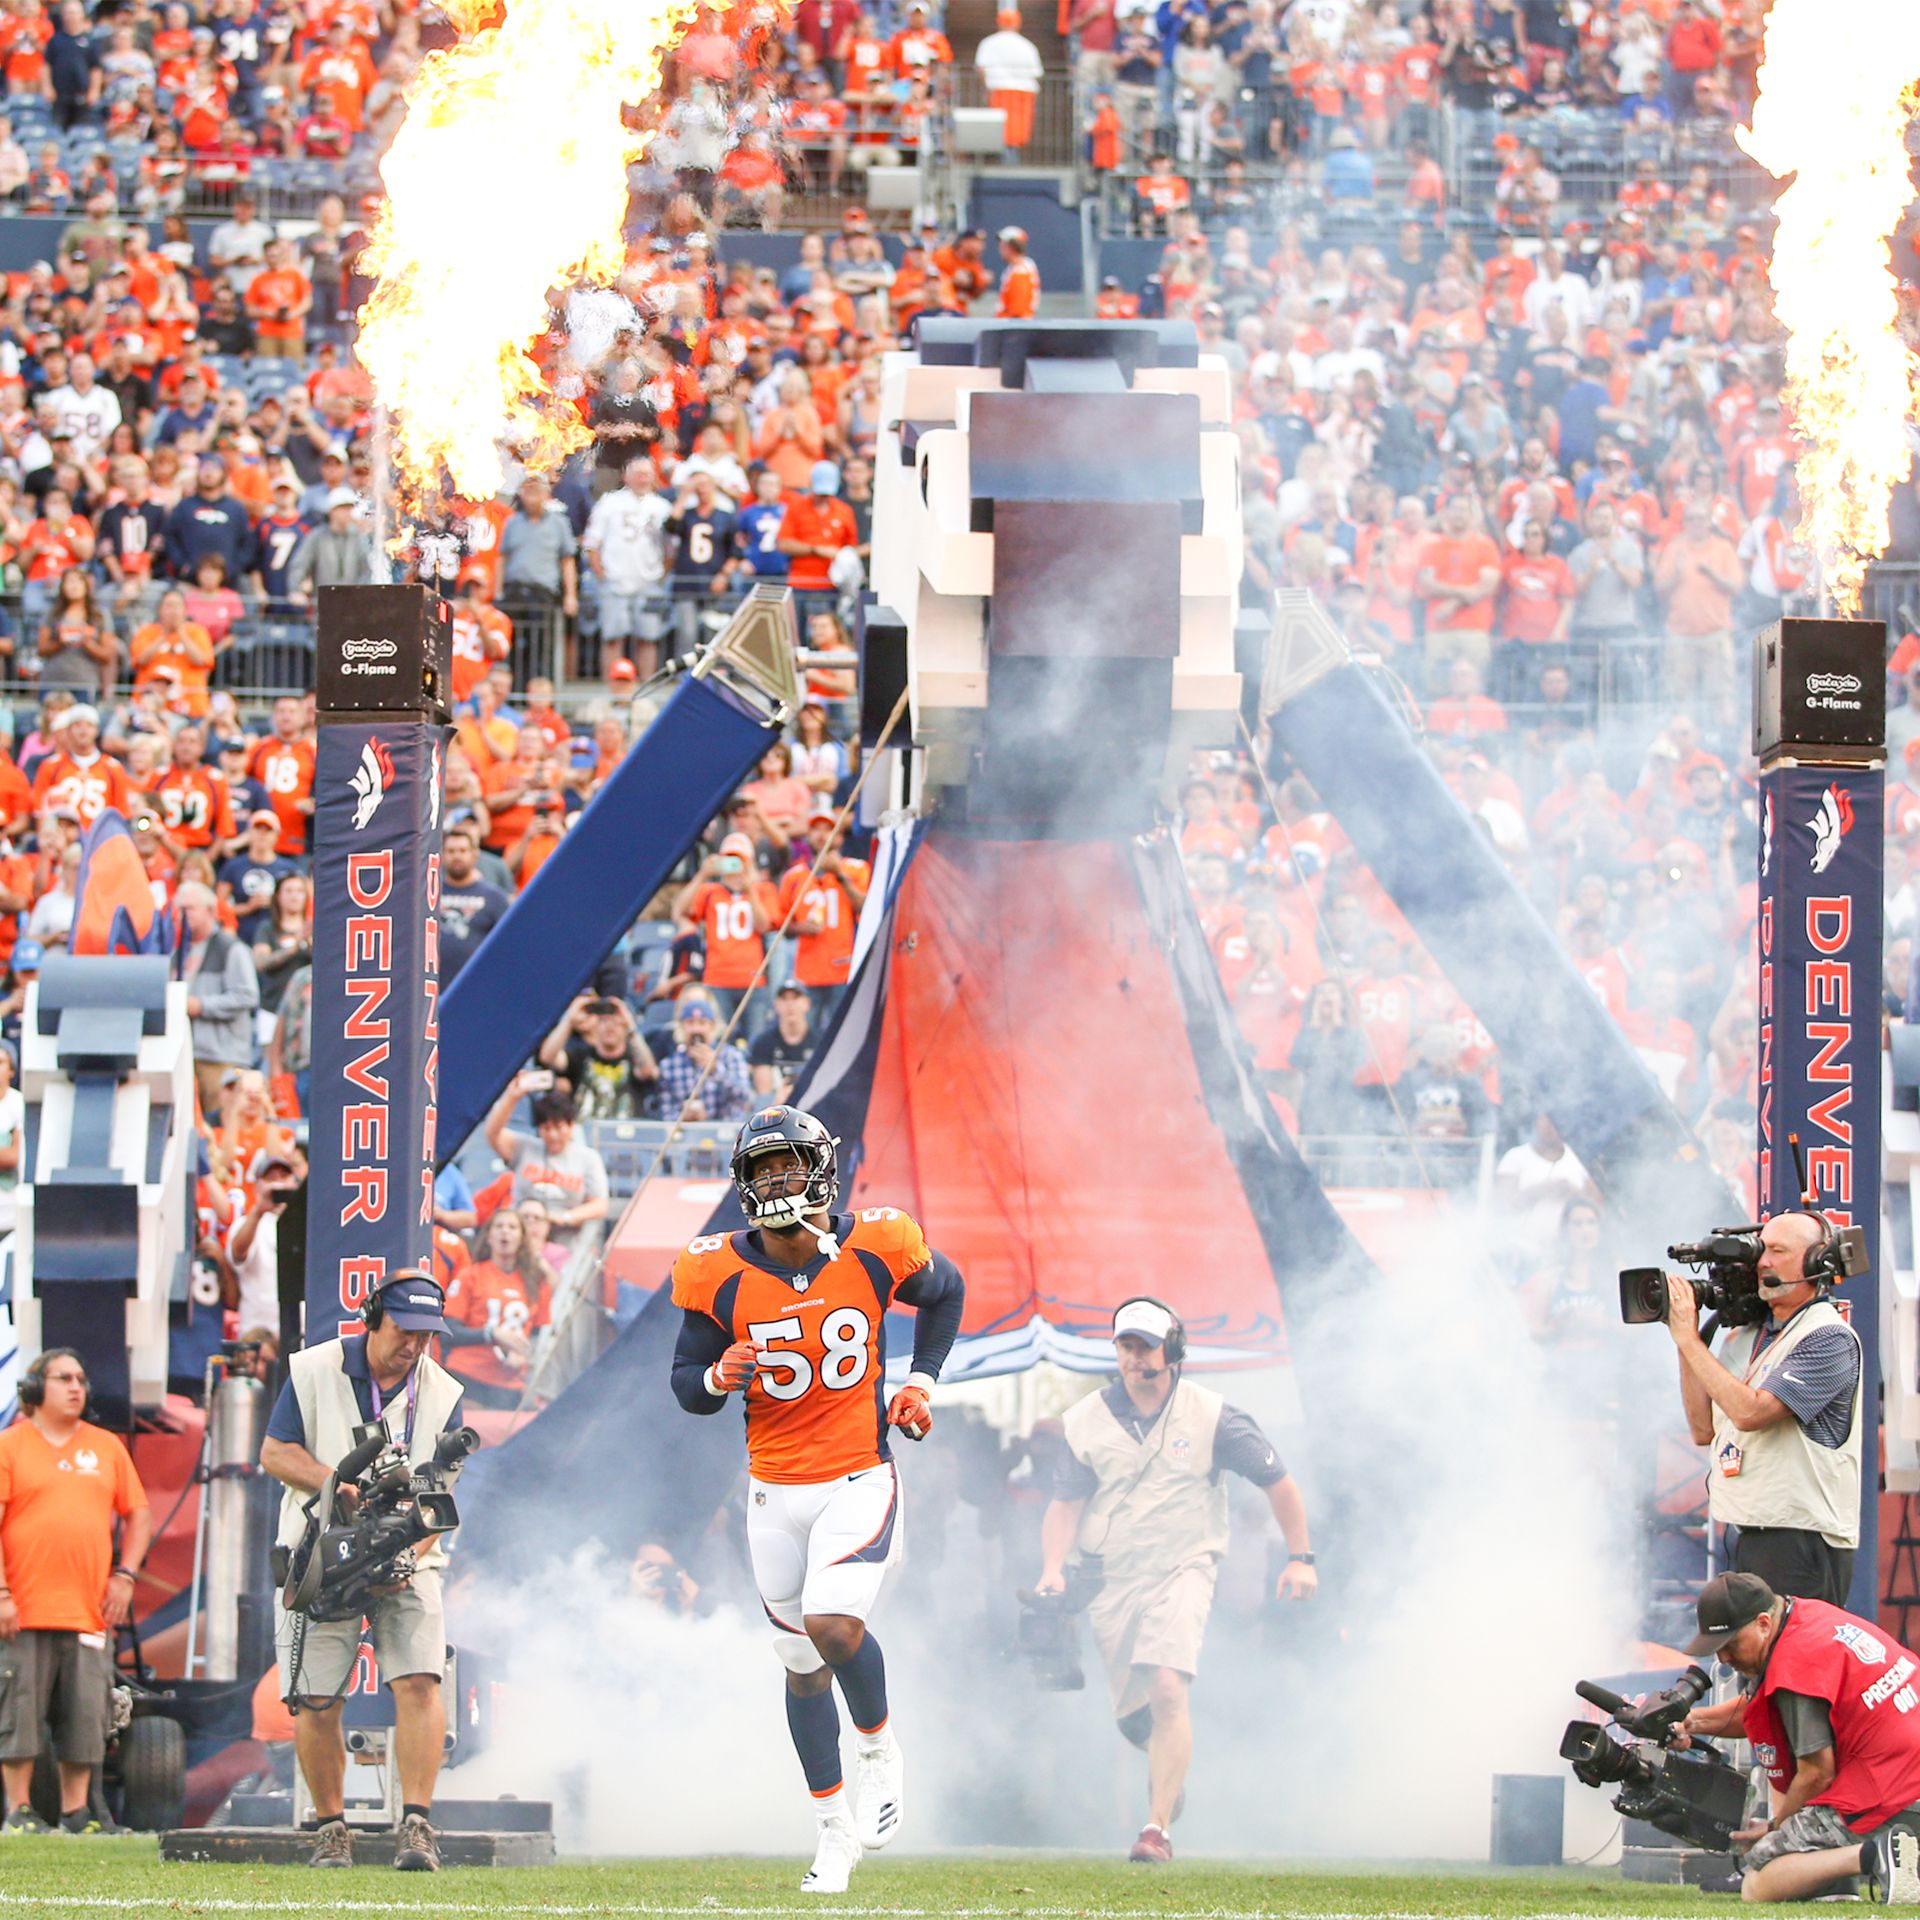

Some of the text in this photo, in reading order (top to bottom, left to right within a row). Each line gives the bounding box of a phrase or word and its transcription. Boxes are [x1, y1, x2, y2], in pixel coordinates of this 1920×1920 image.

[64, 412, 102, 439] 58
[690, 522, 714, 564] 6
[341, 663, 397, 676] G-Flame
[1806, 696, 1862, 711] G-Flame
[265, 755, 299, 793] 18
[714, 901, 754, 941] 10
[803, 888, 840, 929] 21
[342, 849, 393, 1228] DENVER
[781, 1298, 825, 1313] BRONCOS
[747, 1307, 870, 1401] 58
